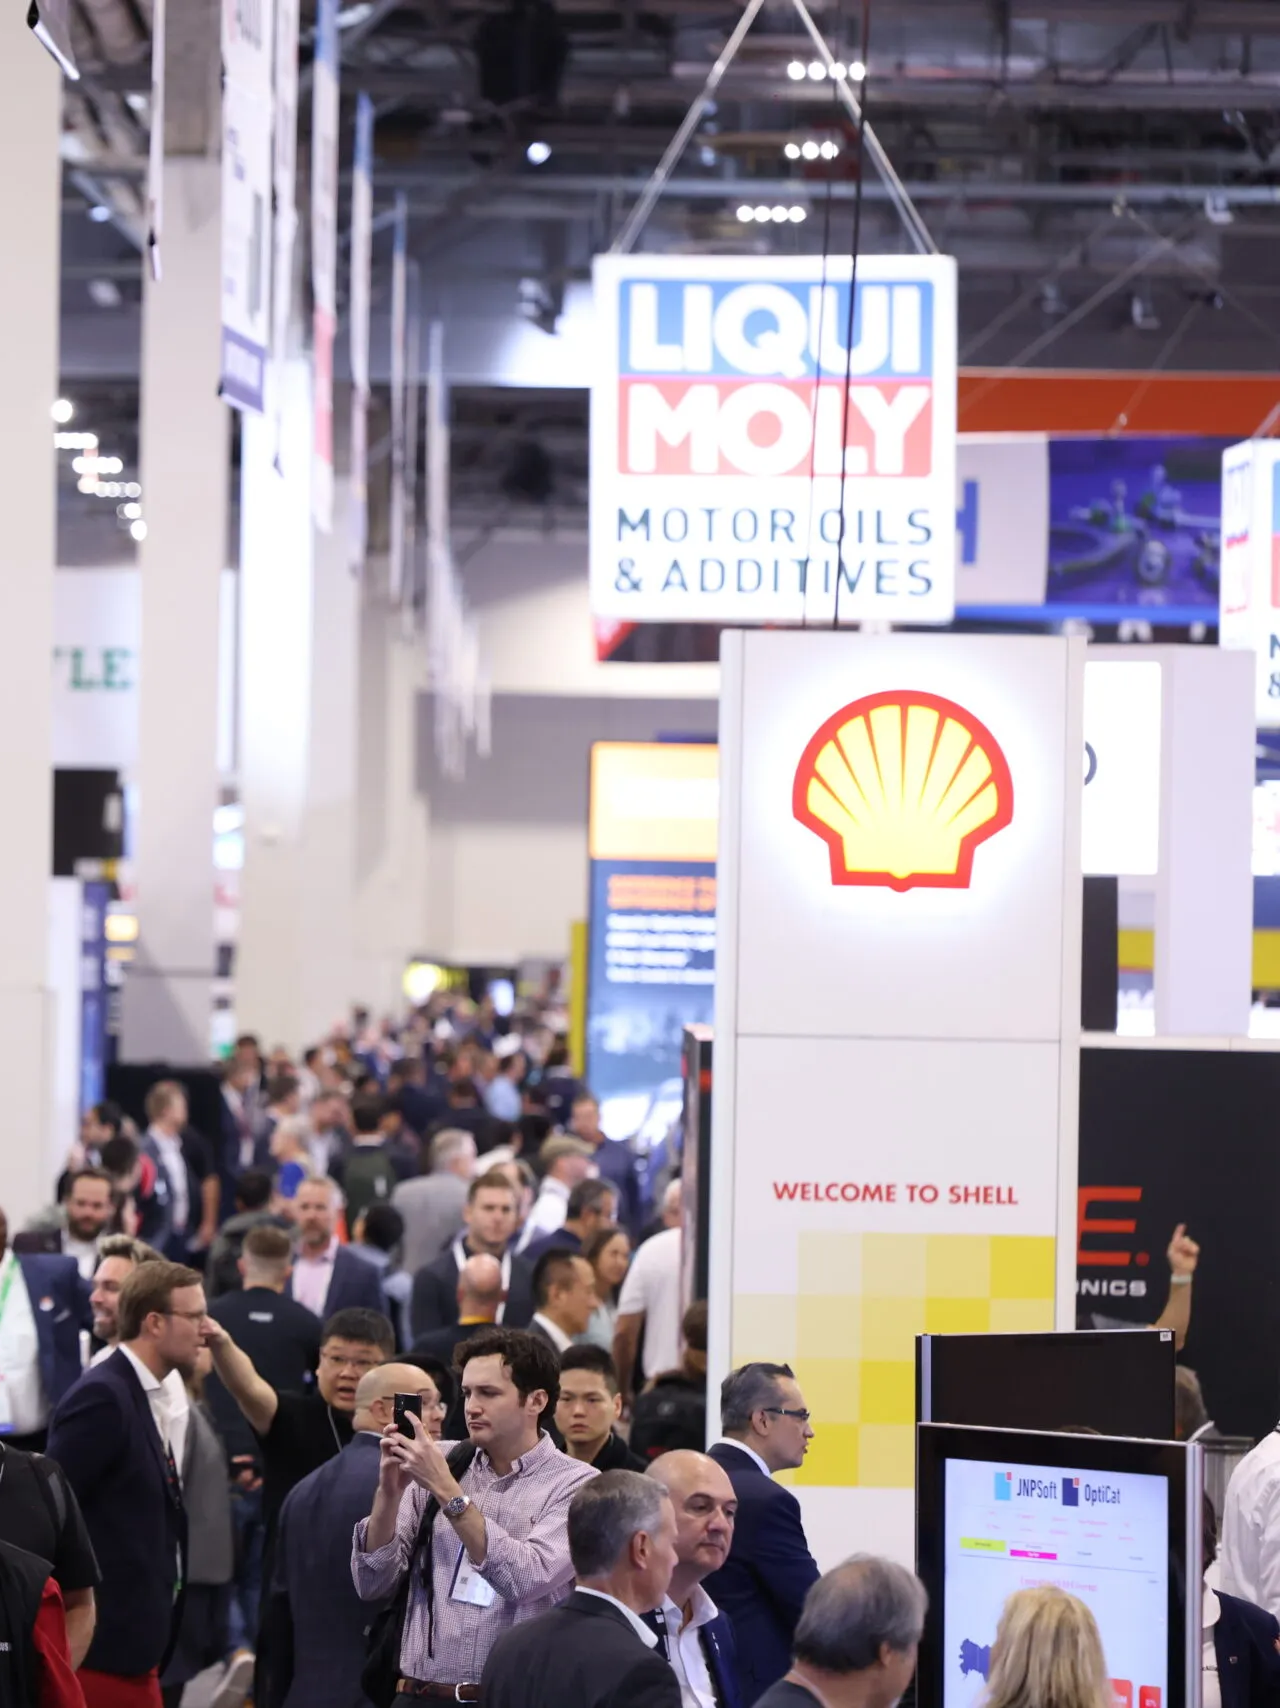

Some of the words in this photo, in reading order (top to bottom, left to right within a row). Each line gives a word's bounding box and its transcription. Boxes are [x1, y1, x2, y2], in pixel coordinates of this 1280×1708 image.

[629, 282, 922, 380] LIQUI
[628, 381, 932, 476] MOLY
[617, 508, 796, 543] MOTOR
[820, 508, 933, 545] OILS
[615, 557, 643, 593] &
[660, 558, 933, 596] ADDITIVES
[773, 1182, 897, 1203] WELCOME
[906, 1184, 939, 1204] TO
[948, 1185, 1019, 1206] SHELL
[1075, 1279, 1147, 1297] NICS
[1016, 1478, 1057, 1500] JNPSoft
[1084, 1483, 1121, 1507] OptiCat
